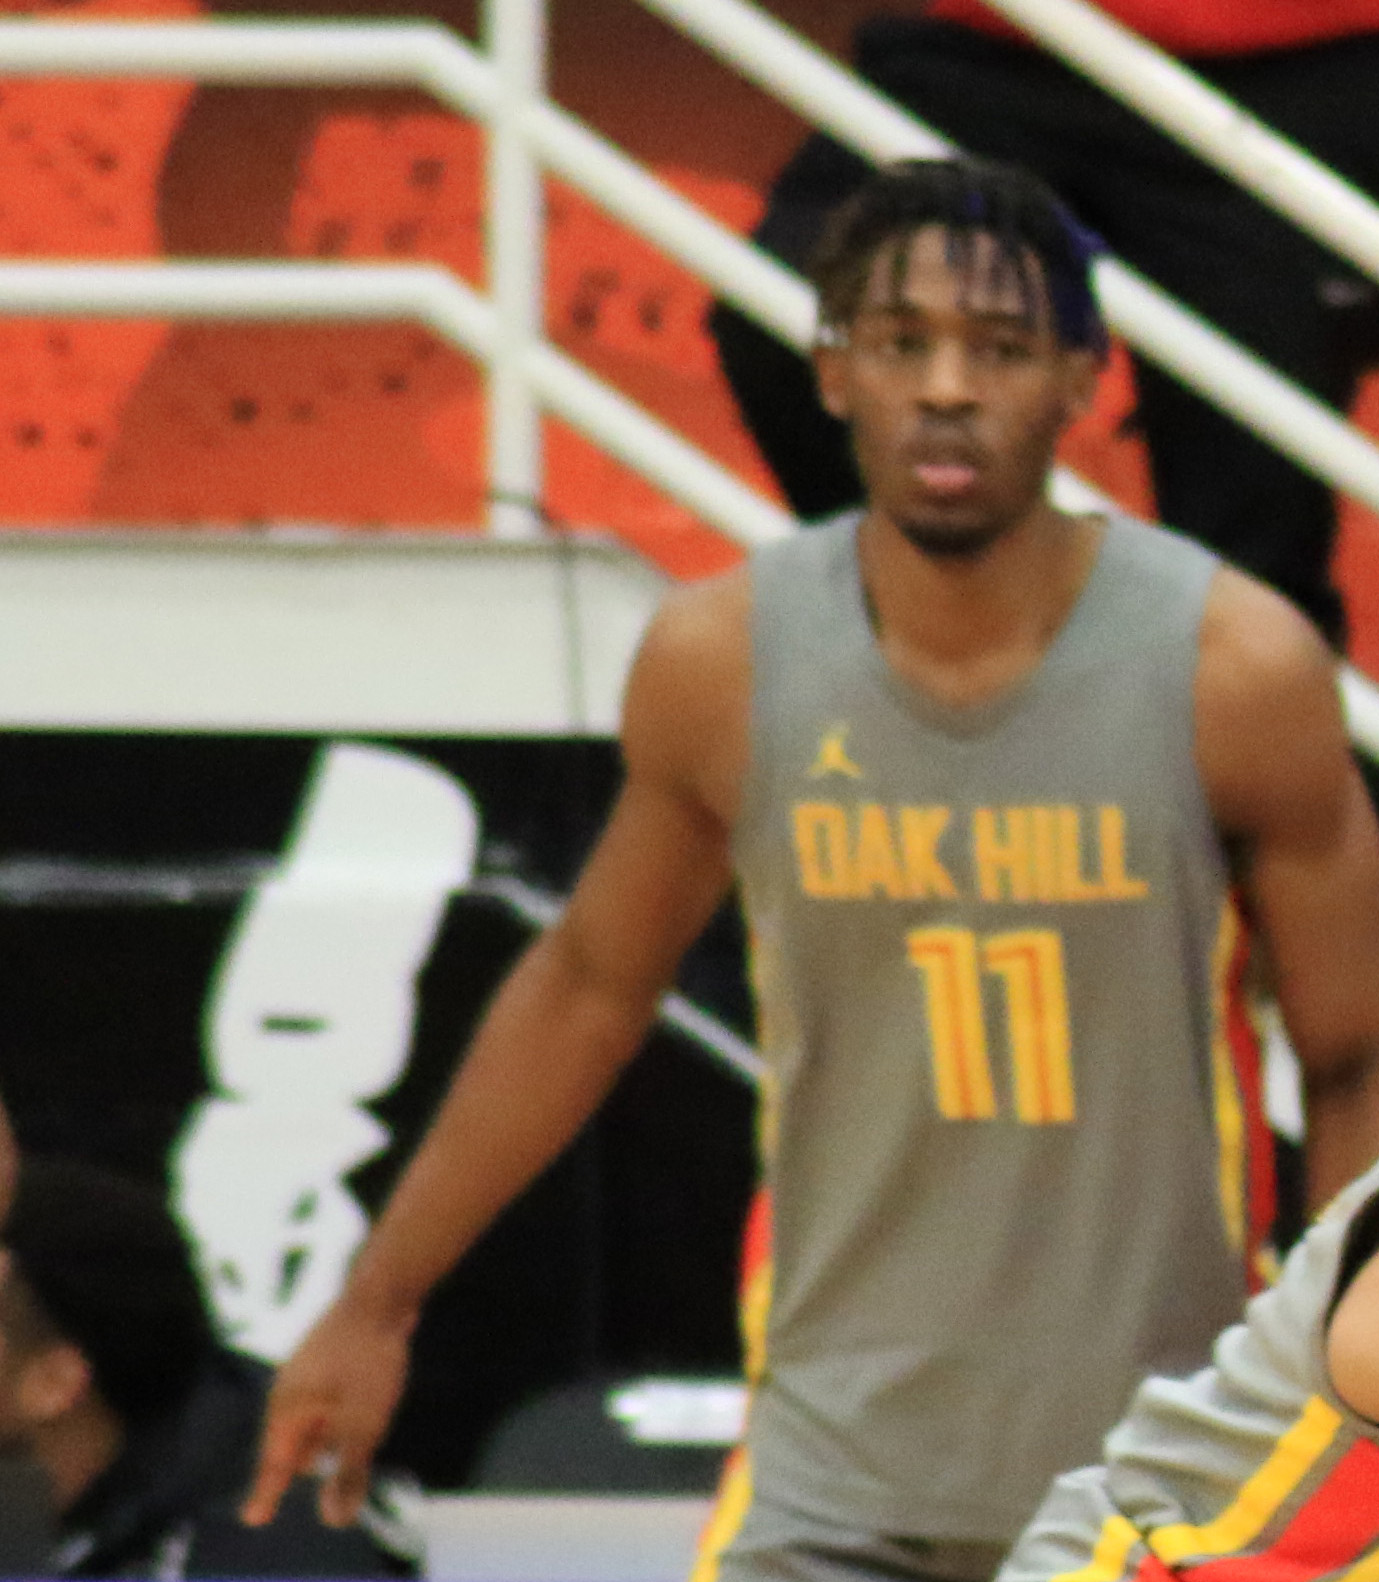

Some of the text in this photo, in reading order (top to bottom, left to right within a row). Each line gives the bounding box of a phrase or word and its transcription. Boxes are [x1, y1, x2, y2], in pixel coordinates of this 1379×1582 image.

[794, 803, 1150, 903] OAK HILL
[906, 926, 1076, 1125] 11
